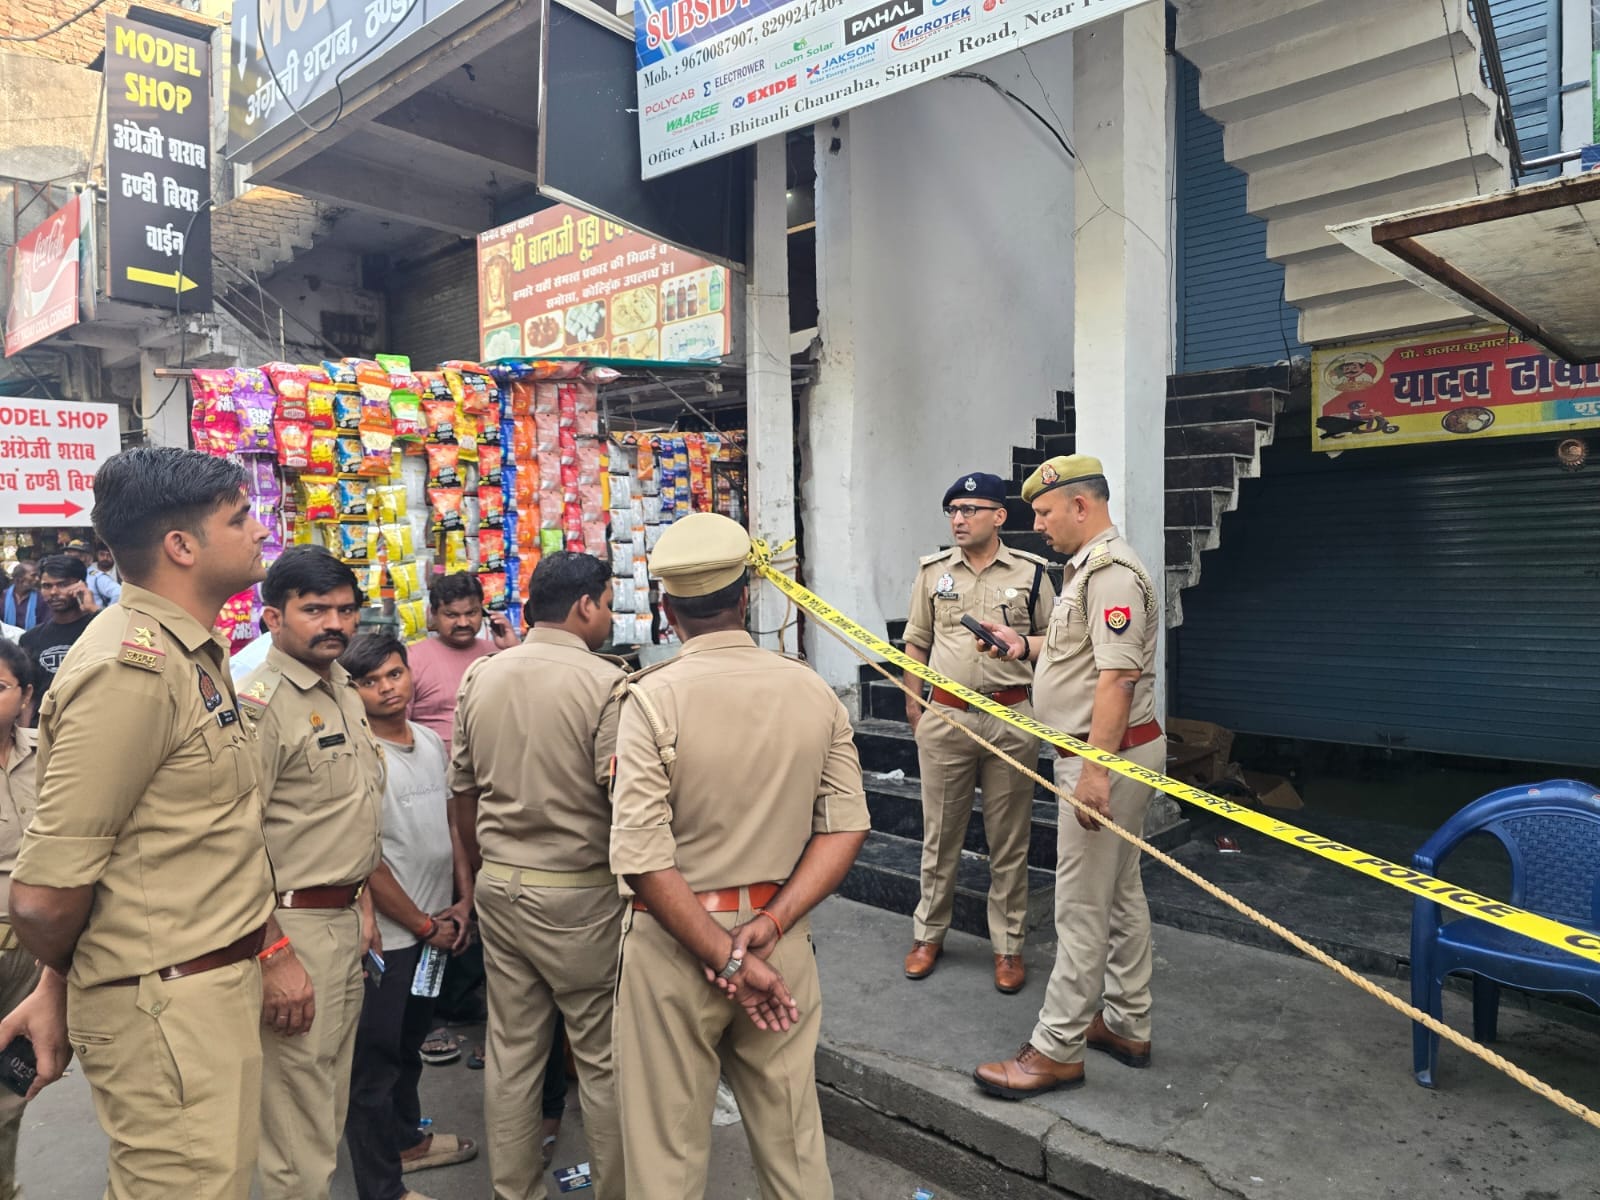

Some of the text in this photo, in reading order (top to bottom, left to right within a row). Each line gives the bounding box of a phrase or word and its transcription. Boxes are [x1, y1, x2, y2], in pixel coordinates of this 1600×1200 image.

[646, 0, 750, 48] SUBSID
[681, 27, 758, 73] 9670087907,
[762, 0, 842, 38] 829924740
[851, 1, 915, 36] PAHAL
[898, 5, 971, 42] MICROTEK
[115, 25, 201, 78] MODEL
[303, 19, 358, 82] शराब,
[775, 54, 803, 70] Loom
[806, 41, 834, 58] Solar
[822, 42, 875, 69] JAKSON
[124, 72, 192, 114] SHOP
[645, 88, 695, 116] POLYCAB
[648, 145, 685, 166] Office
[729, 103, 789, 137] Bhitauli
[794, 77, 880, 114] Chauraha,
[885, 49, 952, 81] Sitapur
[958, 22, 1017, 54] Road,
[1024, 2, 1075, 30] Near
[747, 75, 797, 105] EXIDE
[666, 102, 720, 132] WAAREE
[113, 119, 206, 169] अंग्रेजी शराब
[163, 176, 200, 213] बियर
[511, 233, 526, 272] श्री
[528, 214, 574, 266] बालाजी
[1424, 345, 1460, 357] अजय
[1463, 338, 1505, 352] कुमार
[1390, 361, 1495, 406] यादव
[0, 407, 108, 429] ODEL SHOP
[1, 435, 96, 460] अंग्रेजी शराब
[997, 708, 1099, 751] PROHIBITED
[1295, 834, 1353, 852] UP
[1352, 858, 1526, 918] POLICE
